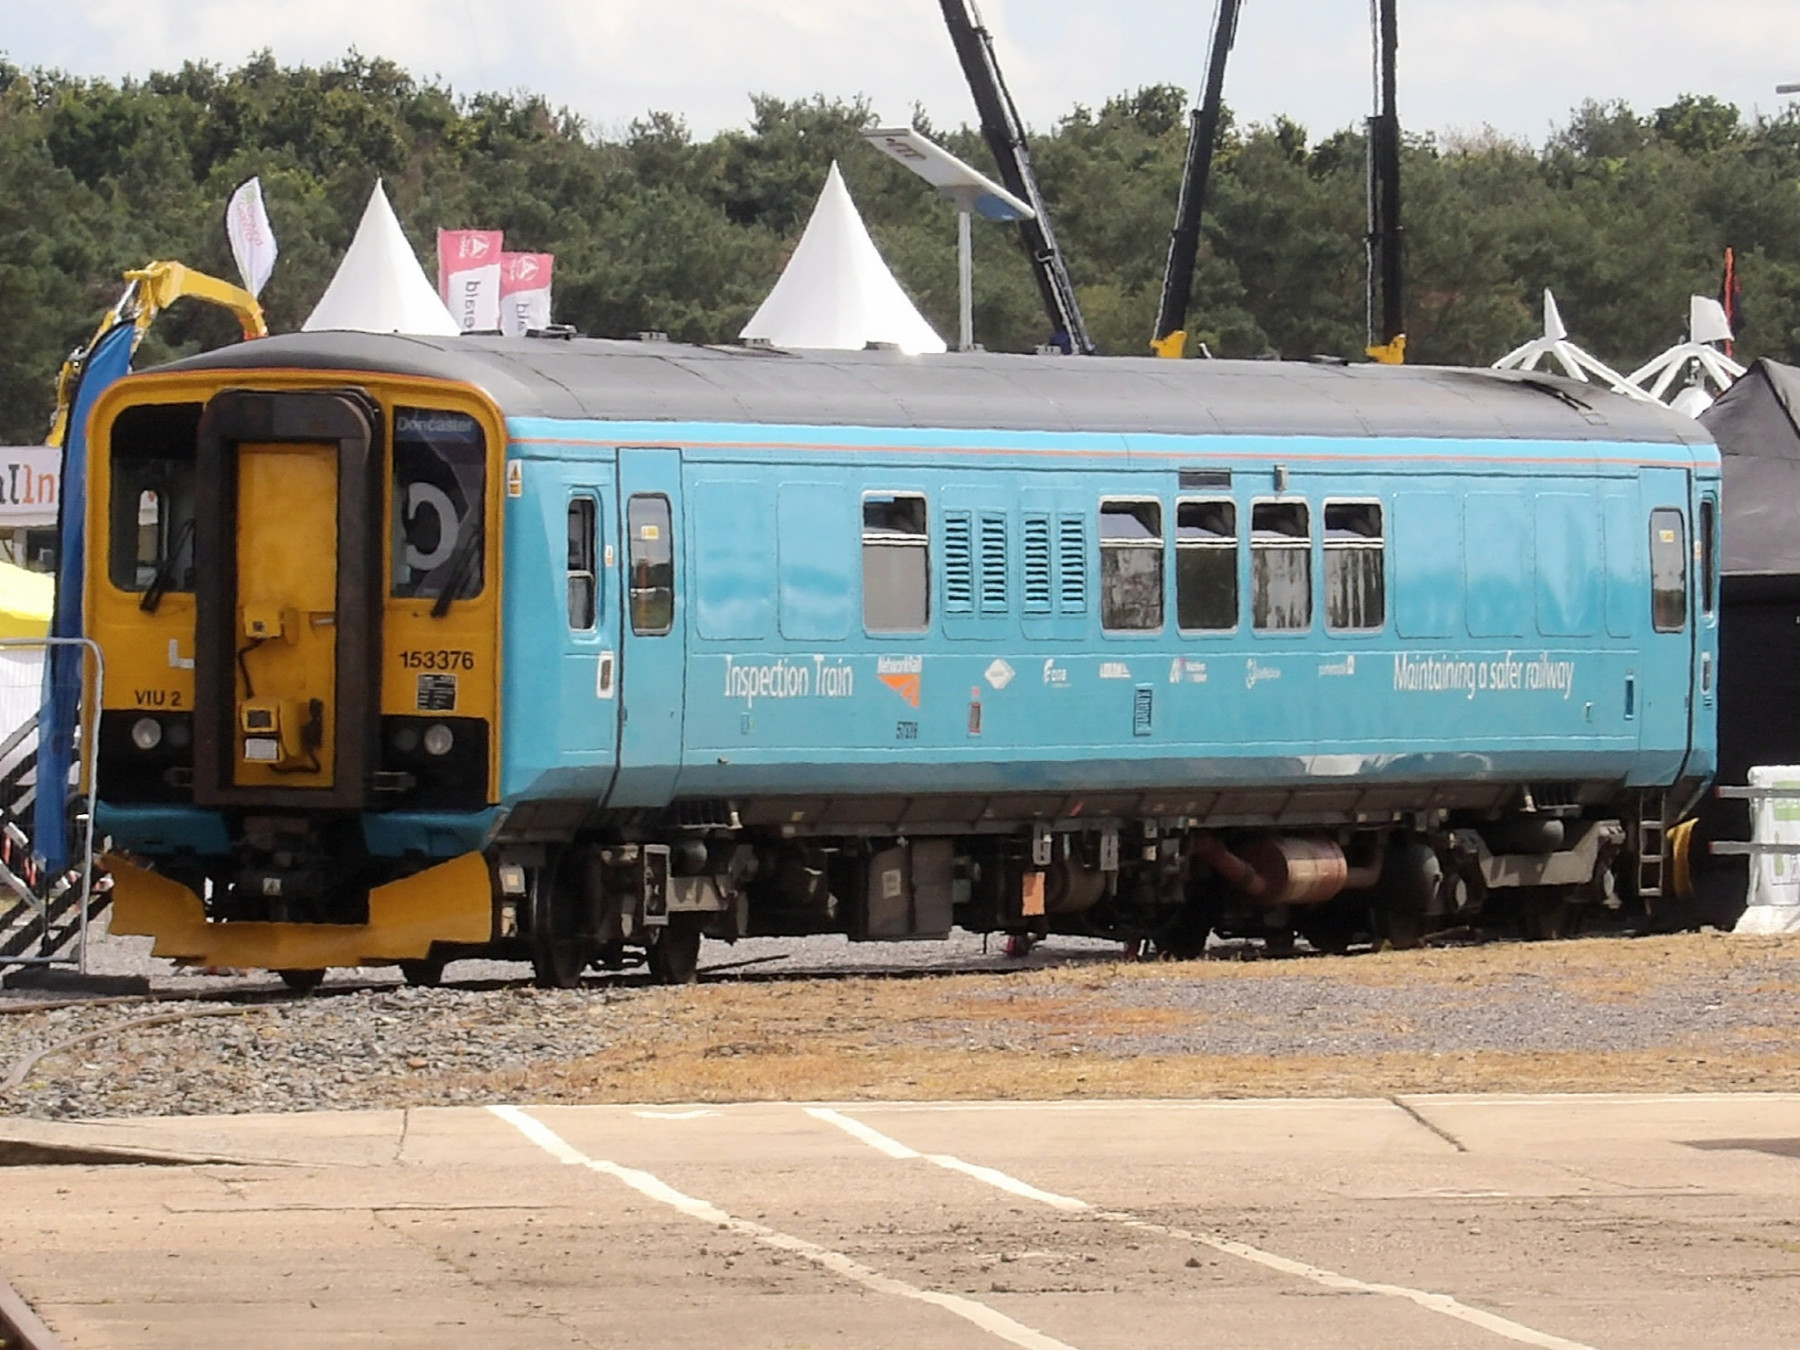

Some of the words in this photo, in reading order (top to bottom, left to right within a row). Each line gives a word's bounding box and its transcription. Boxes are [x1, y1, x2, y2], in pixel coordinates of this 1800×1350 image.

[396, 416, 474, 433] Doncaster
[399, 650, 475, 670] 153376
[724, 654, 809, 709] Inspection
[813, 654, 854, 697] Train
[1394, 652, 1477, 701] Maintaining
[1478, 662, 1488, 690] a
[1490, 650, 1523, 691] safer
[1525, 651, 1575, 700] railway
[135, 689, 166, 706] VIU
[171, 691, 182, 707] 2
